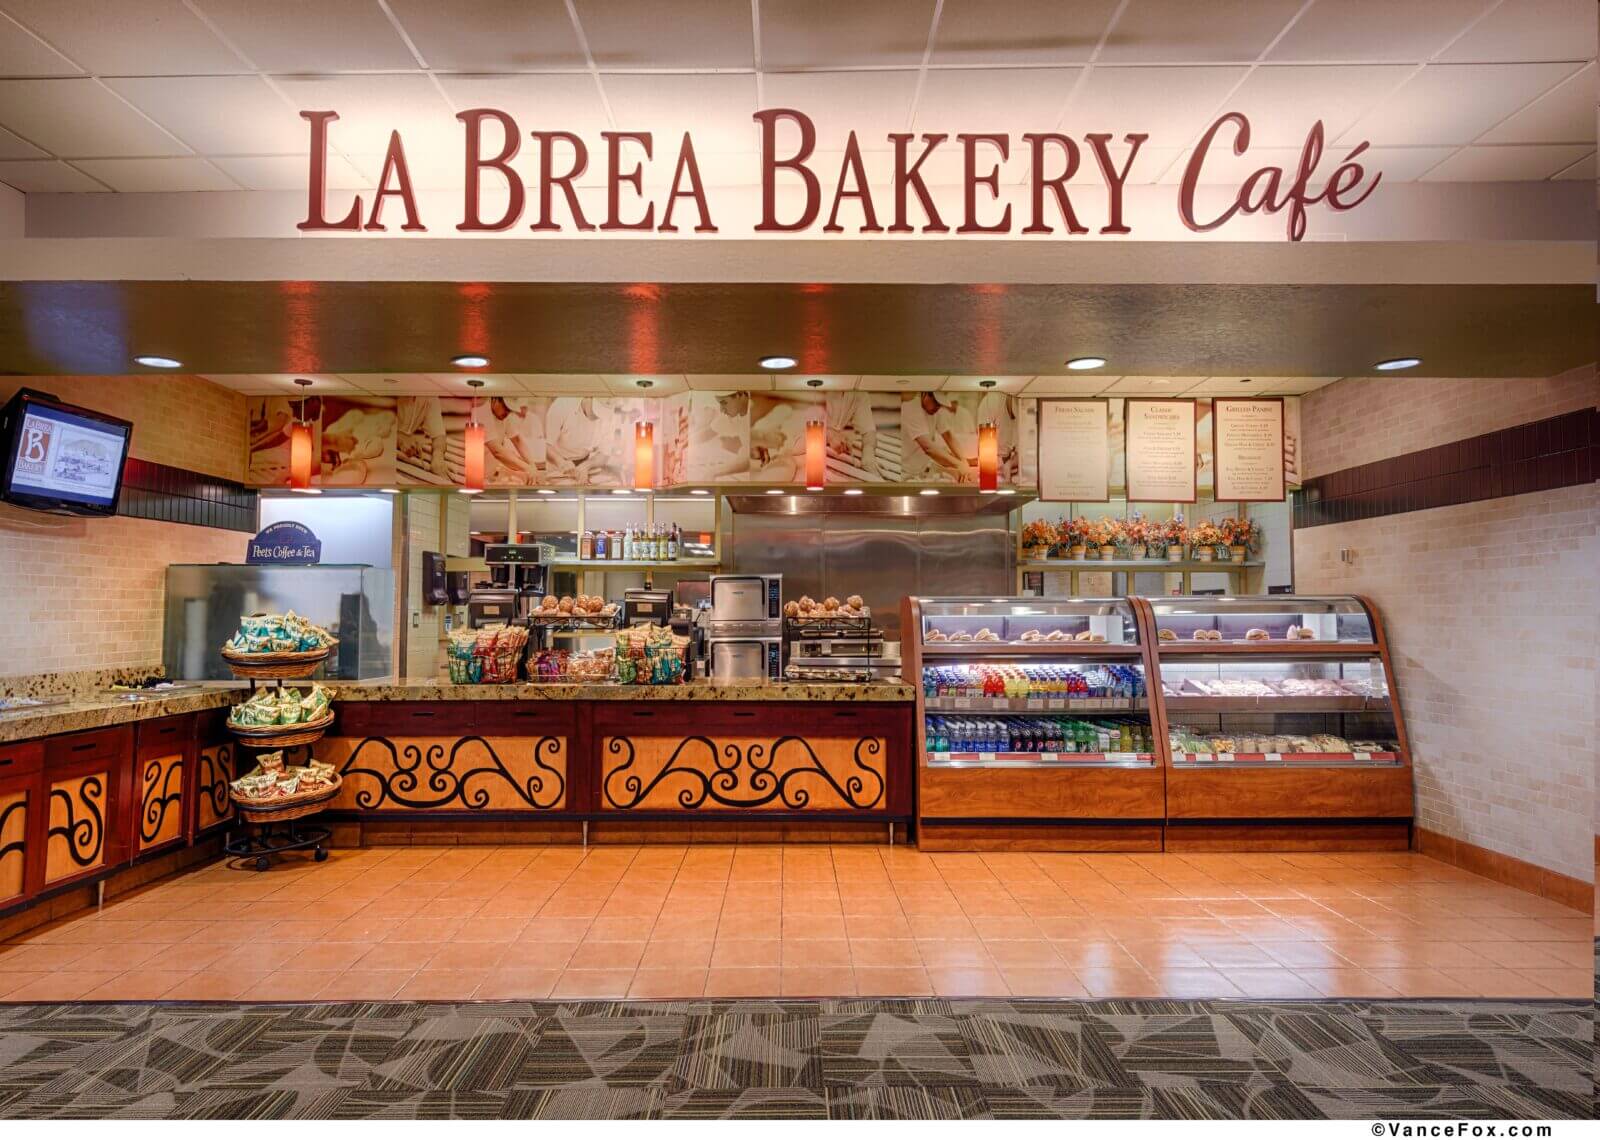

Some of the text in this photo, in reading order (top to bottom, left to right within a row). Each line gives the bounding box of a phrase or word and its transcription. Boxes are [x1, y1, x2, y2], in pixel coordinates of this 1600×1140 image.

[297, 108, 1382, 242] LA BREA BAKERY Café
[272, 545, 296, 559] Coffee
[302, 545, 316, 558] Tea
